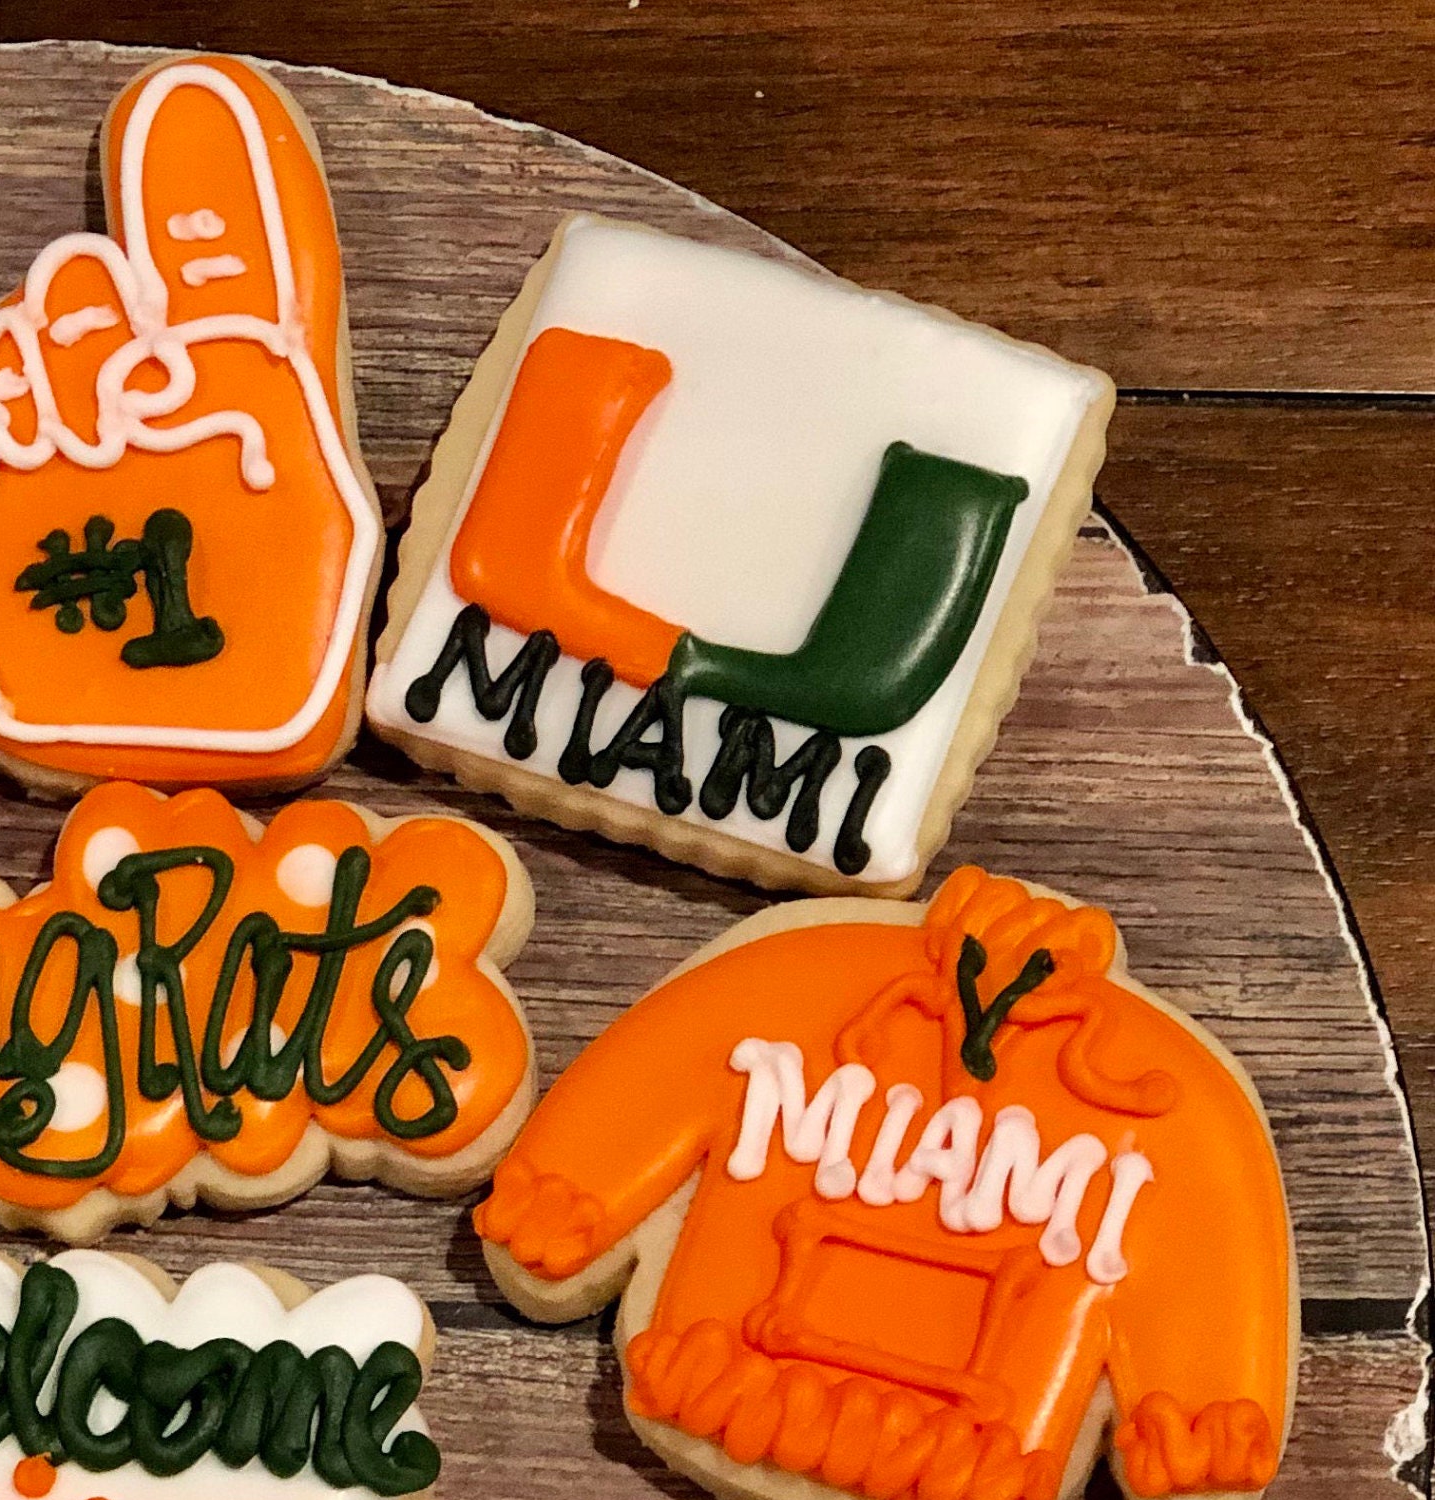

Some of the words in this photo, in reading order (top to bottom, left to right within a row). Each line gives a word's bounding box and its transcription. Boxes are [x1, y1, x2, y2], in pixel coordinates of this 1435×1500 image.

[15, 508, 224, 667] #1
[405, 603, 891, 875] MIAMI
[728, 1037, 1154, 1283] MIAMI
